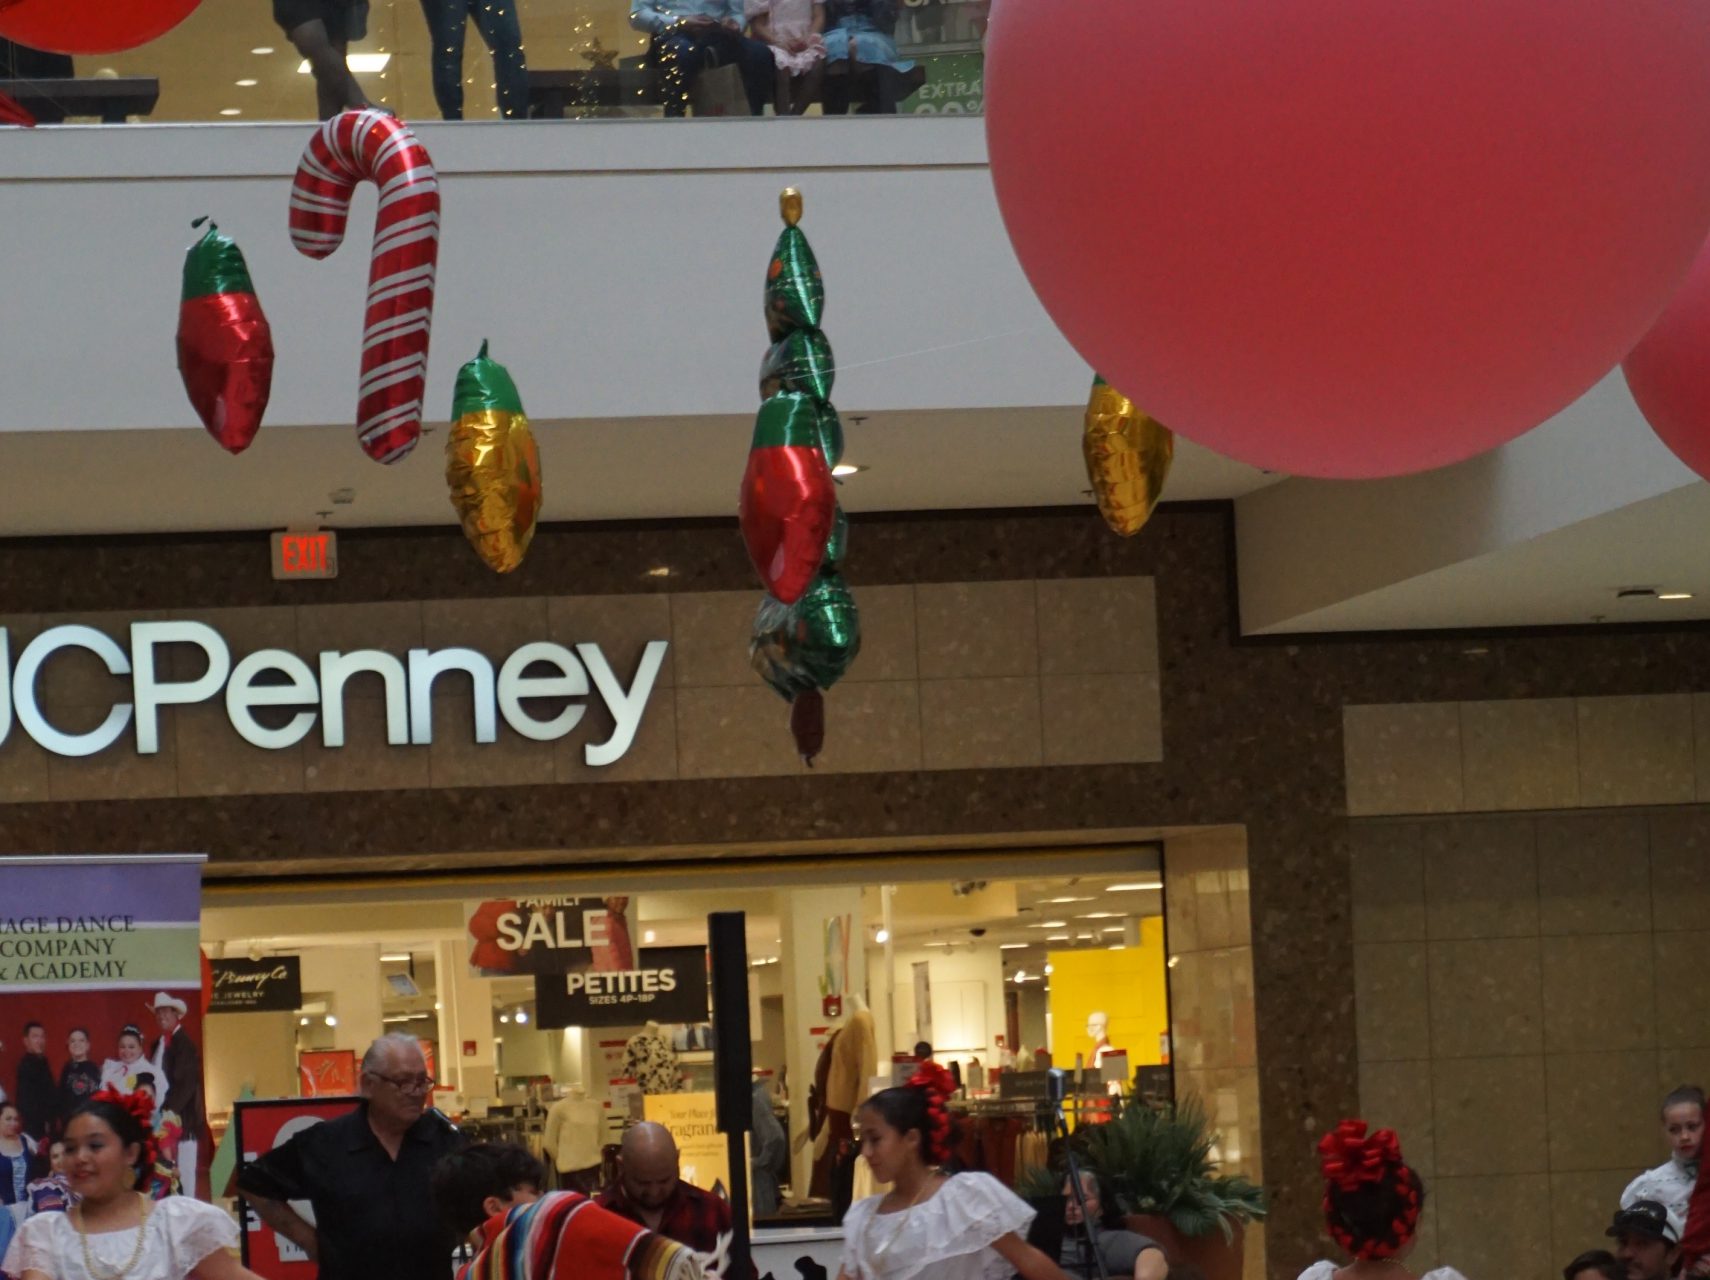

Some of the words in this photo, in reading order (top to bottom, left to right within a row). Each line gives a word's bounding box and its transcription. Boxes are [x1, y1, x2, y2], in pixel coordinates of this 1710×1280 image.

[919, 81, 983, 98] EXTRA
[282, 535, 328, 572] EXIT
[0, 620, 668, 766] CPenney
[56, 915, 136, 934] DANCE
[496, 909, 610, 951] SALE
[0, 938, 115, 958] COMPANY
[15, 960, 128, 980] ACADEMY
[567, 969, 676, 995] PETITES
[589, 995, 618, 1005] SIZES
